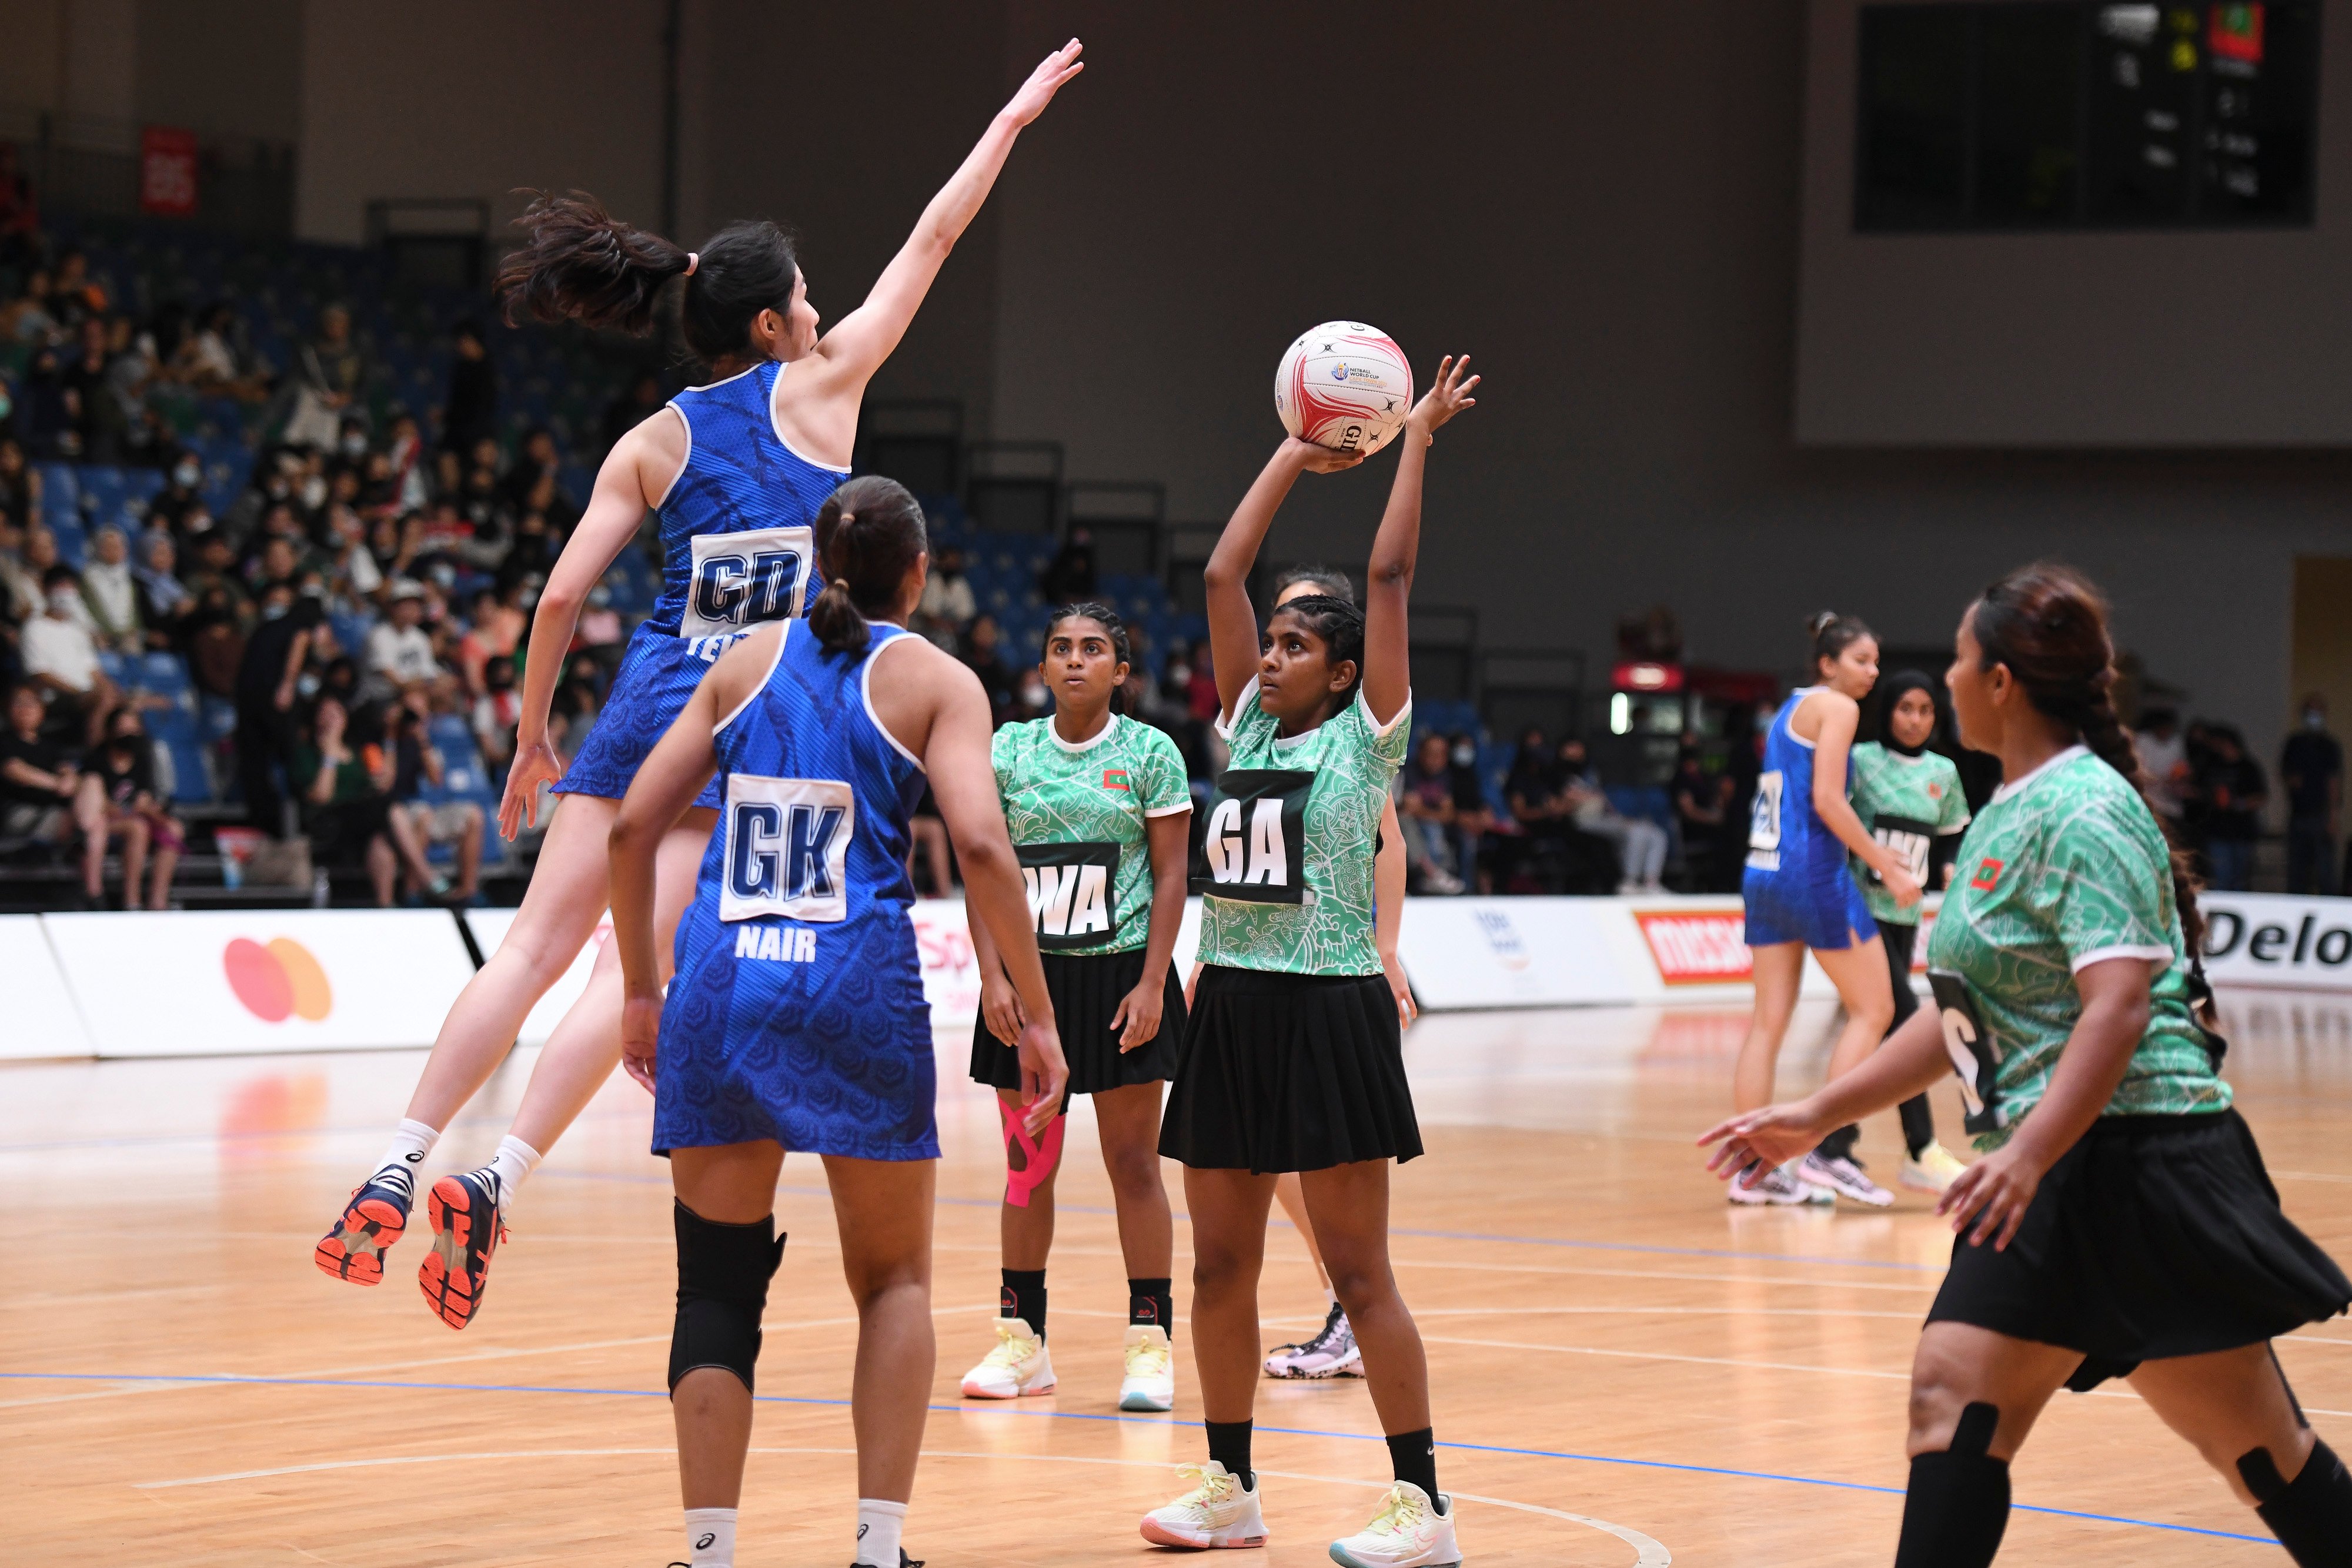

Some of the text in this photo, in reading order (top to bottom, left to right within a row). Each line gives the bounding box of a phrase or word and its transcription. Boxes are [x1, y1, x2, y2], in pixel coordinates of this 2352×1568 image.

[694, 550, 801, 624] GD
[729, 802, 846, 902] GK
[1207, 798, 1287, 885] GA
[1021, 864, 1110, 936] WA
[735, 925, 817, 962] NAIR
[2204, 911, 2352, 964] Delo
